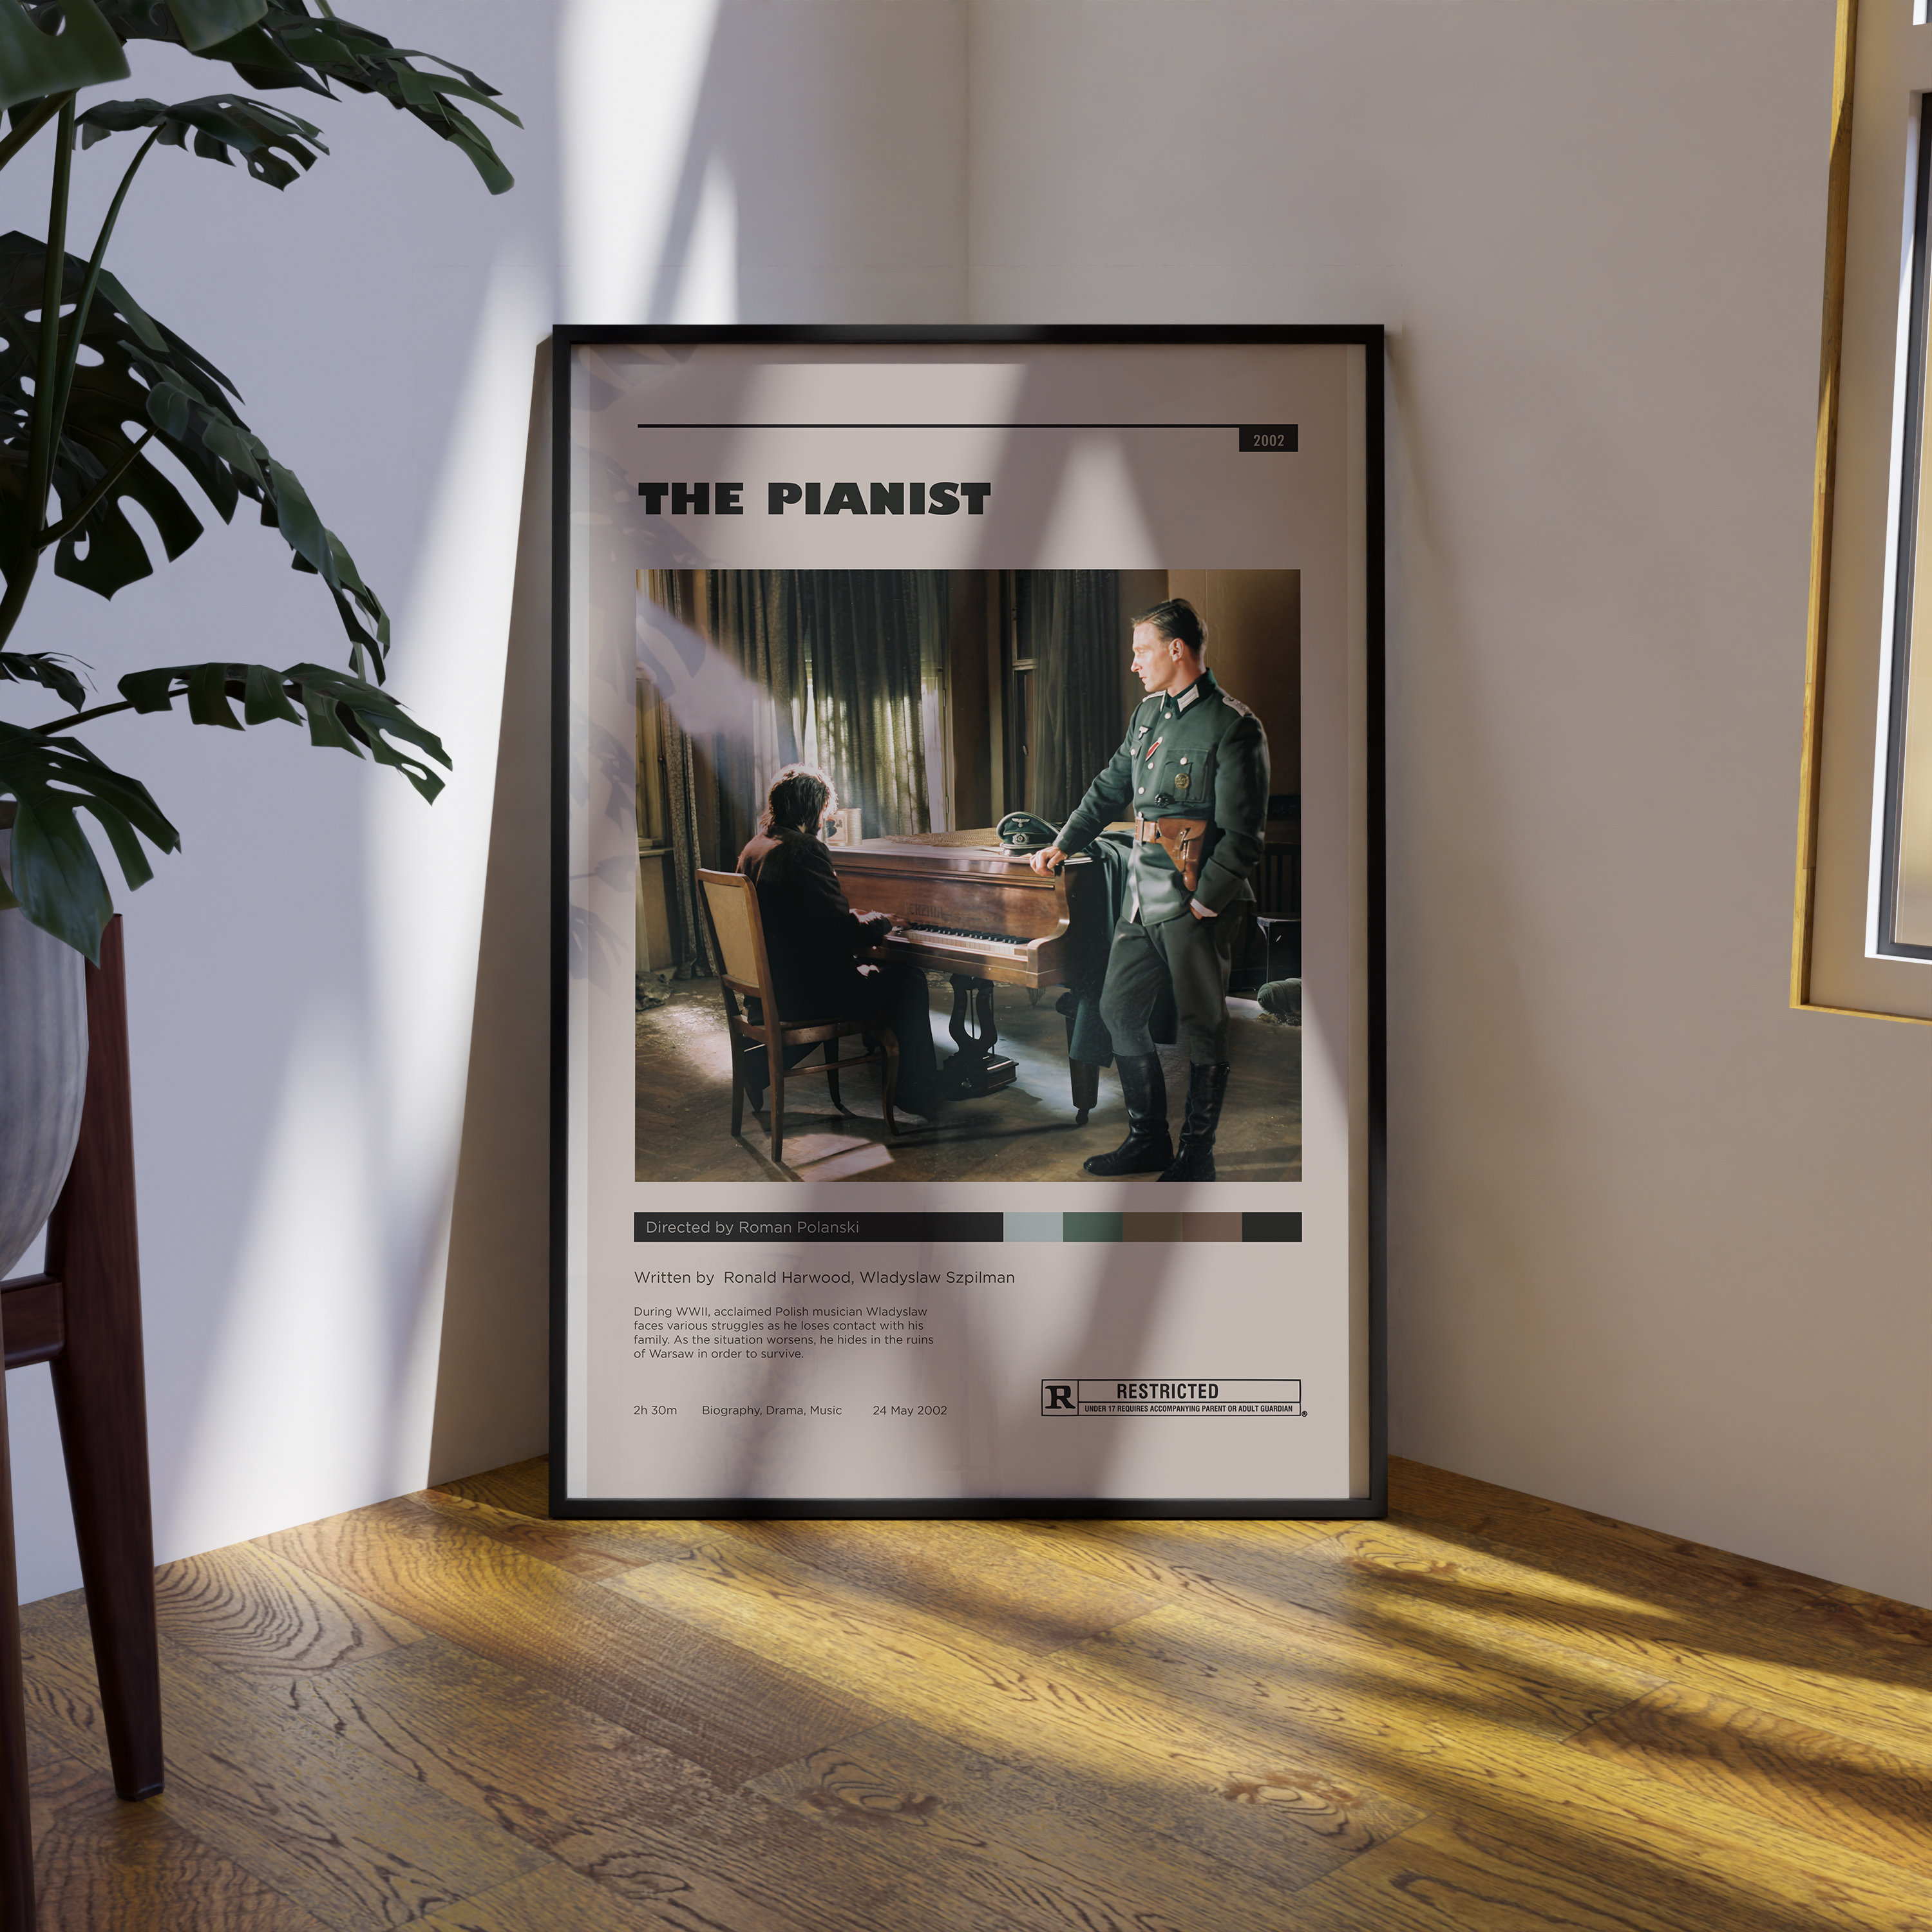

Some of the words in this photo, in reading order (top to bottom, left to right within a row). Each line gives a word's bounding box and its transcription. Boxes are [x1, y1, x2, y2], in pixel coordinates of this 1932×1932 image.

[1253, 434, 1285, 447] 2002
[638, 482, 744, 515] THE
[768, 482, 991, 516] PIANIST
[647, 1220, 710, 1233] Directed
[715, 1220, 734, 1236] by
[739, 1221, 791, 1233] Roman
[798, 1220, 859, 1233] Polanski
[634, 1271, 691, 1283] Written
[696, 1271, 715, 1286] by
[724, 1271, 776, 1283] Ronald
[782, 1271, 854, 1285] Harwood,
[859, 1271, 941, 1286] Wladyslaw
[946, 1271, 1015, 1286] Szpilman
[634, 1307, 672, 1318] During
[676, 1307, 710, 1318] WWII,
[714, 1306, 772, 1316] acclaimed
[775, 1306, 809, 1316] Polish
[813, 1306, 862, 1316] musician
[866, 1306, 927, 1318] Wladyslaw
[634, 1320, 663, 1331] faces
[667, 1320, 708, 1331] various
[711, 1320, 764, 1332] struggles
[784, 1320, 797, 1331] he
[801, 1320, 829, 1331] loses
[833, 1321, 876, 1331] contact
[880, 1320, 904, 1331] with
[908, 1320, 923, 1331] his
[634, 1334, 670, 1347] family.
[674, 1335, 688, 1345] As
[692, 1334, 710, 1345] the
[714, 1334, 762, 1345] situation
[766, 1336, 816, 1345] worsens,
[820, 1334, 834, 1345] he
[837, 1334, 867, 1345] hides
[871, 1334, 880, 1345] in
[884, 1334, 903, 1345] the
[907, 1334, 934, 1345] ruins
[634, 1348, 646, 1359] of
[649, 1349, 694, 1359] Warsaw
[697, 1349, 708, 1358] in
[711, 1349, 743, 1359] order
[746, 1349, 757, 1359] to
[761, 1349, 804, 1359] survive.
[1045, 1385, 1076, 1410] R
[1117, 1383, 1218, 1399] RESTRICTED
[633, 1405, 647, 1415] 2h
[651, 1405, 677, 1416] 30m
[702, 1405, 762, 1417] Biography,
[766, 1405, 806, 1416] Drama,
[810, 1405, 842, 1416] Music
[873, 1405, 887, 1416] 24
[891, 1405, 914, 1417] May
[917, 1405, 947, 1416] 2002
